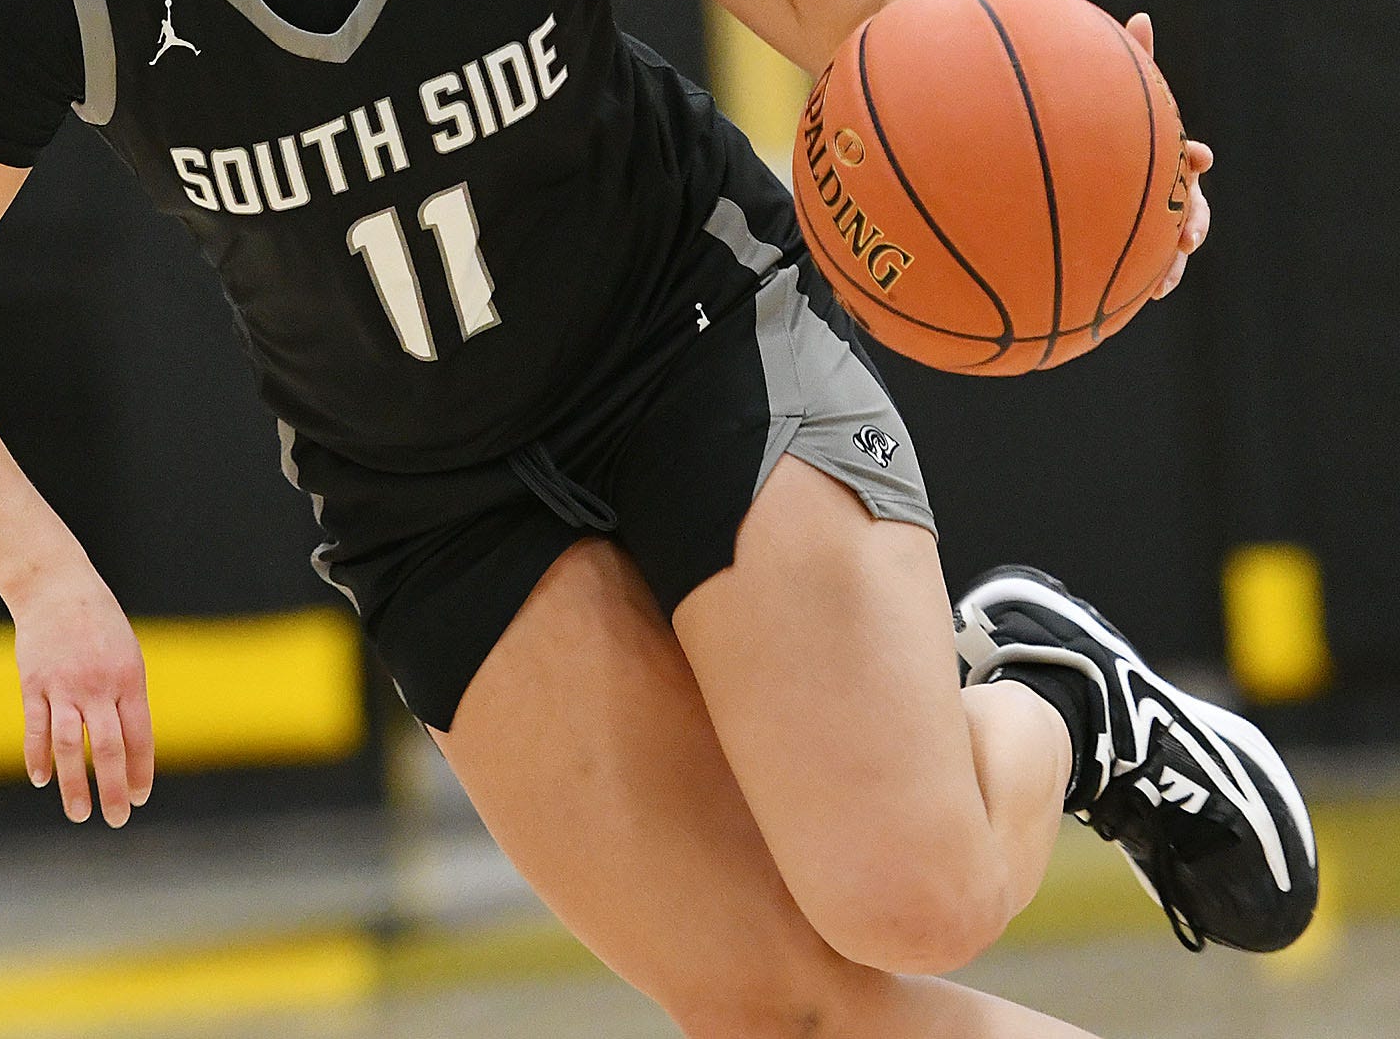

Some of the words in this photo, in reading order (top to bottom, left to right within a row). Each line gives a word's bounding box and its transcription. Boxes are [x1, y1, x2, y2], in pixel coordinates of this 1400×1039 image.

[170, 97, 410, 215] SOUTH
[419, 13, 569, 154] SIDE
[804, 60, 915, 293] PALDING
[346, 181, 502, 362] 11
